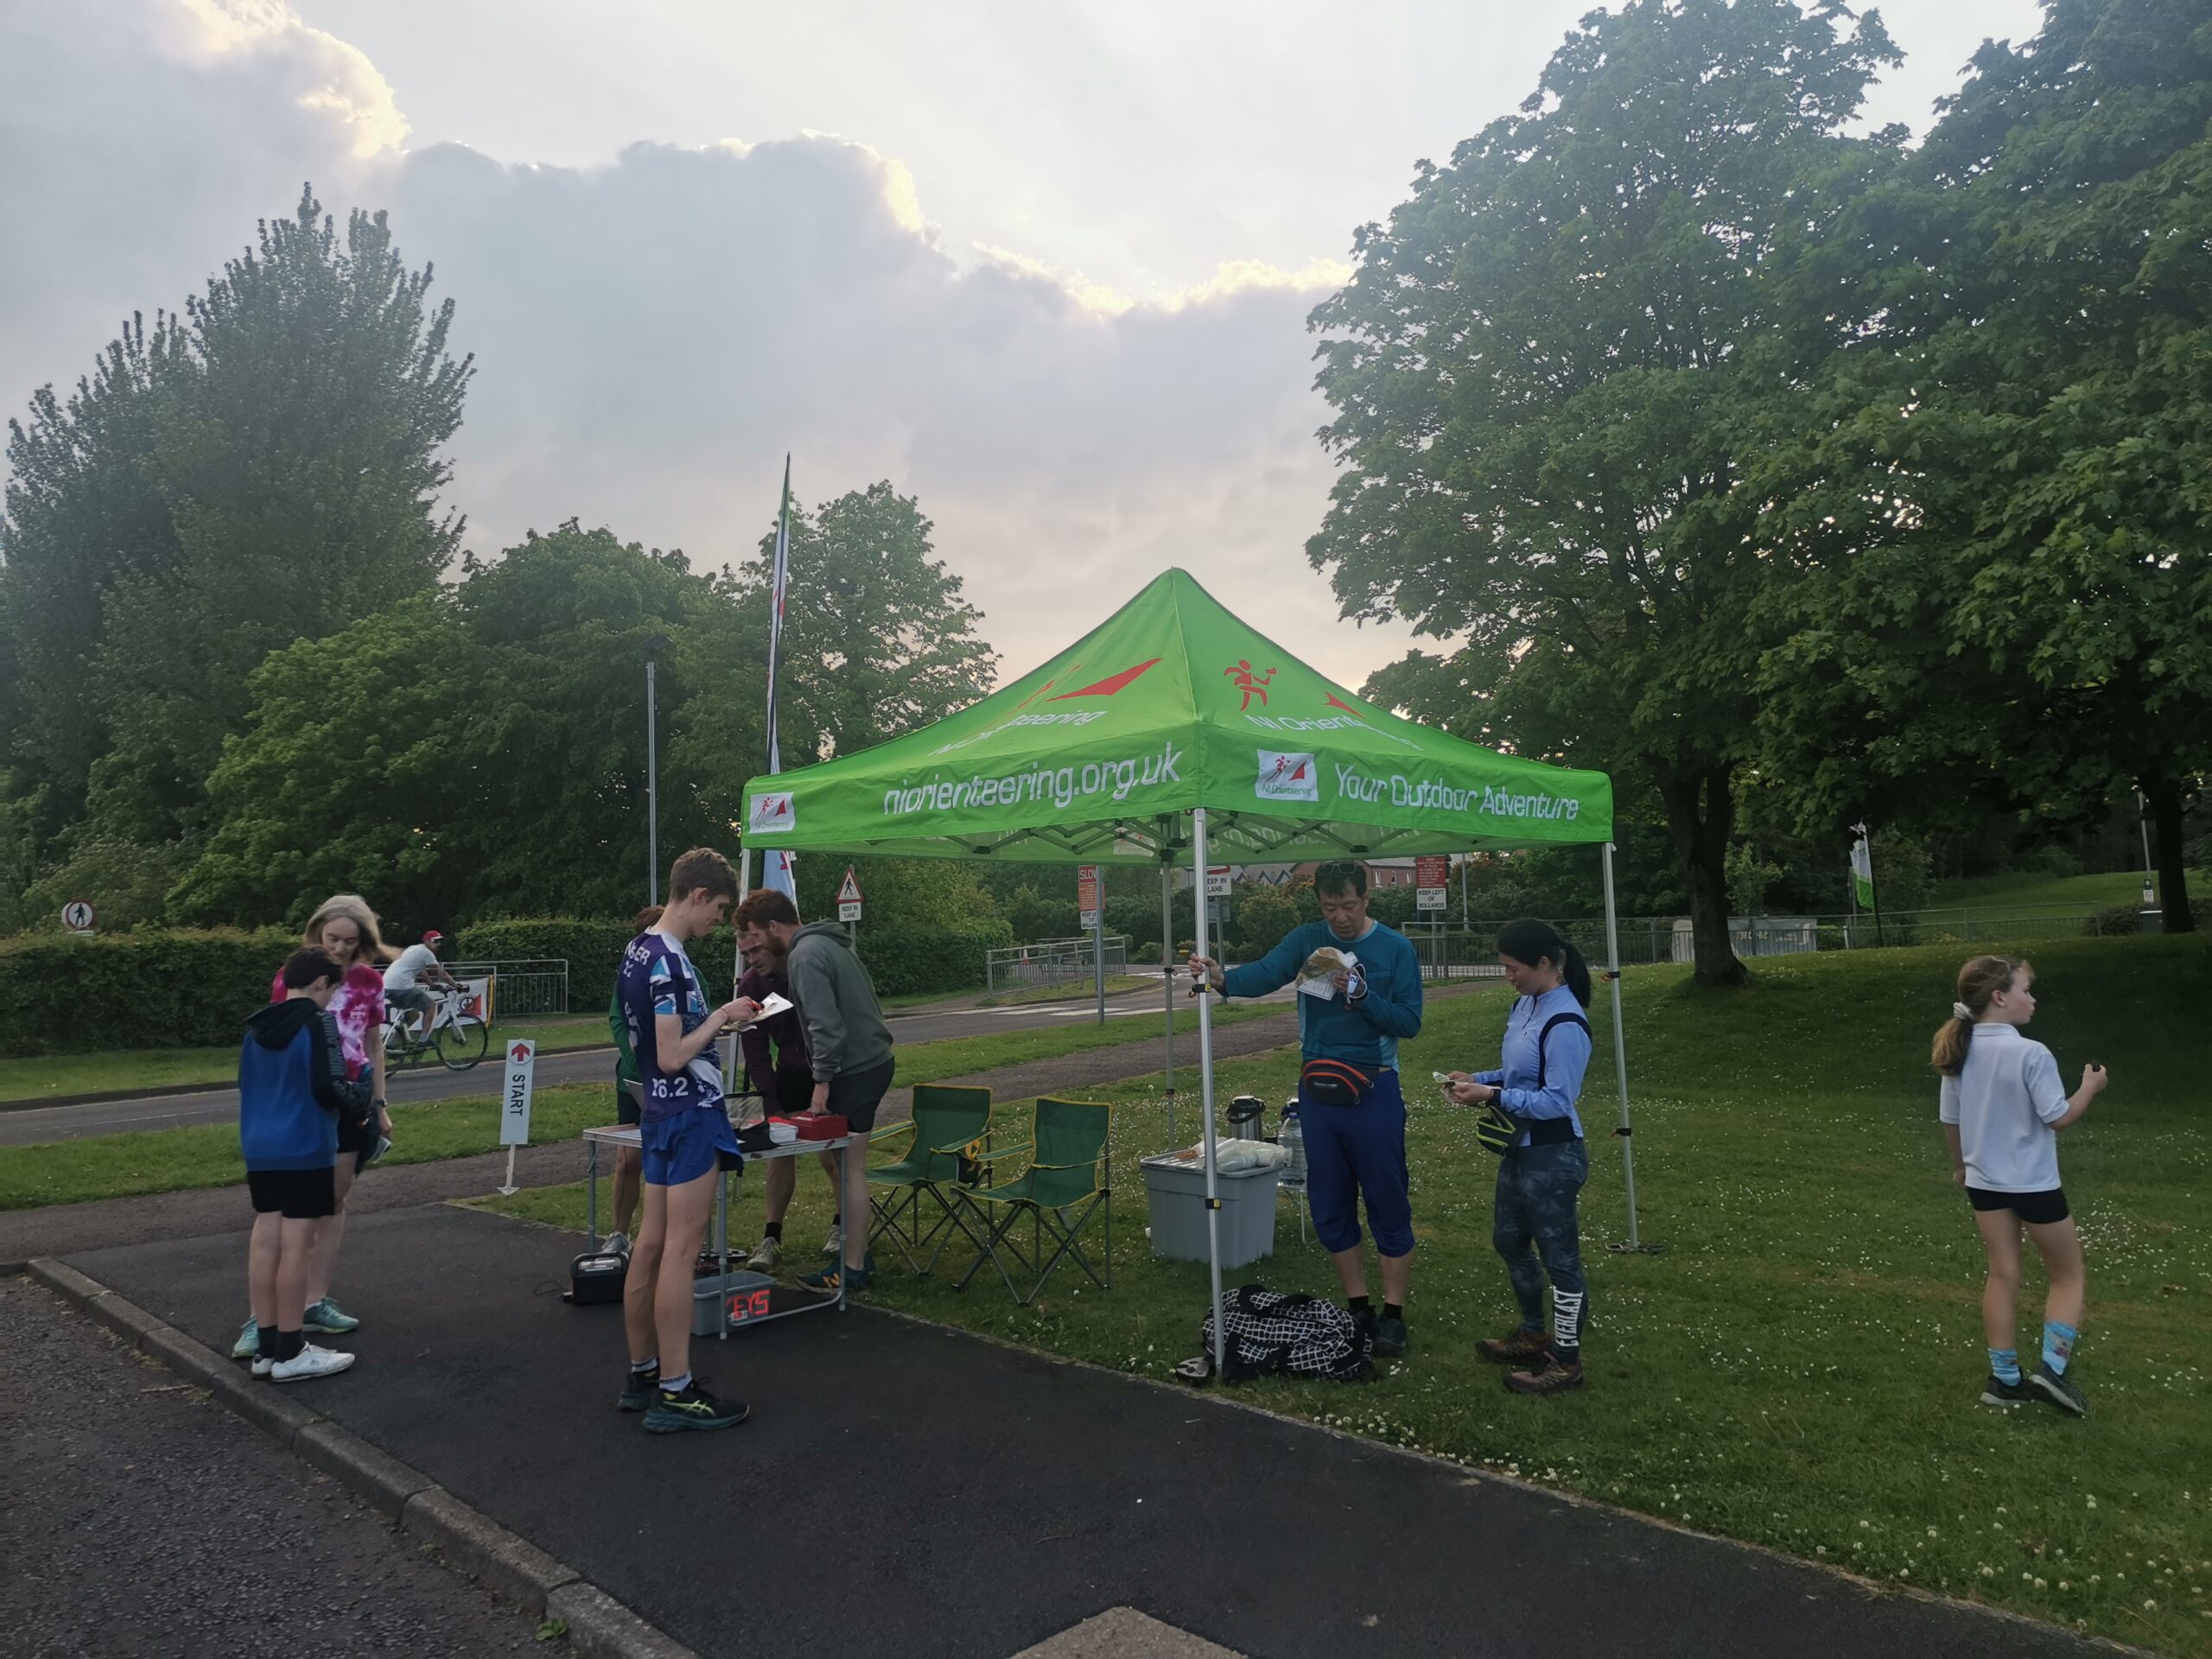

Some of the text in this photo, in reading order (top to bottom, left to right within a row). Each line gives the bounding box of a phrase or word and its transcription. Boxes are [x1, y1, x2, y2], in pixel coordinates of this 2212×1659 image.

[883, 741, 1183, 815] niorienteering.org.uk
[1335, 763, 1580, 821] Your Outdoor Adventure
[510, 1074, 526, 1117] START
[1552, 1285, 1584, 1347] EVERLAST
